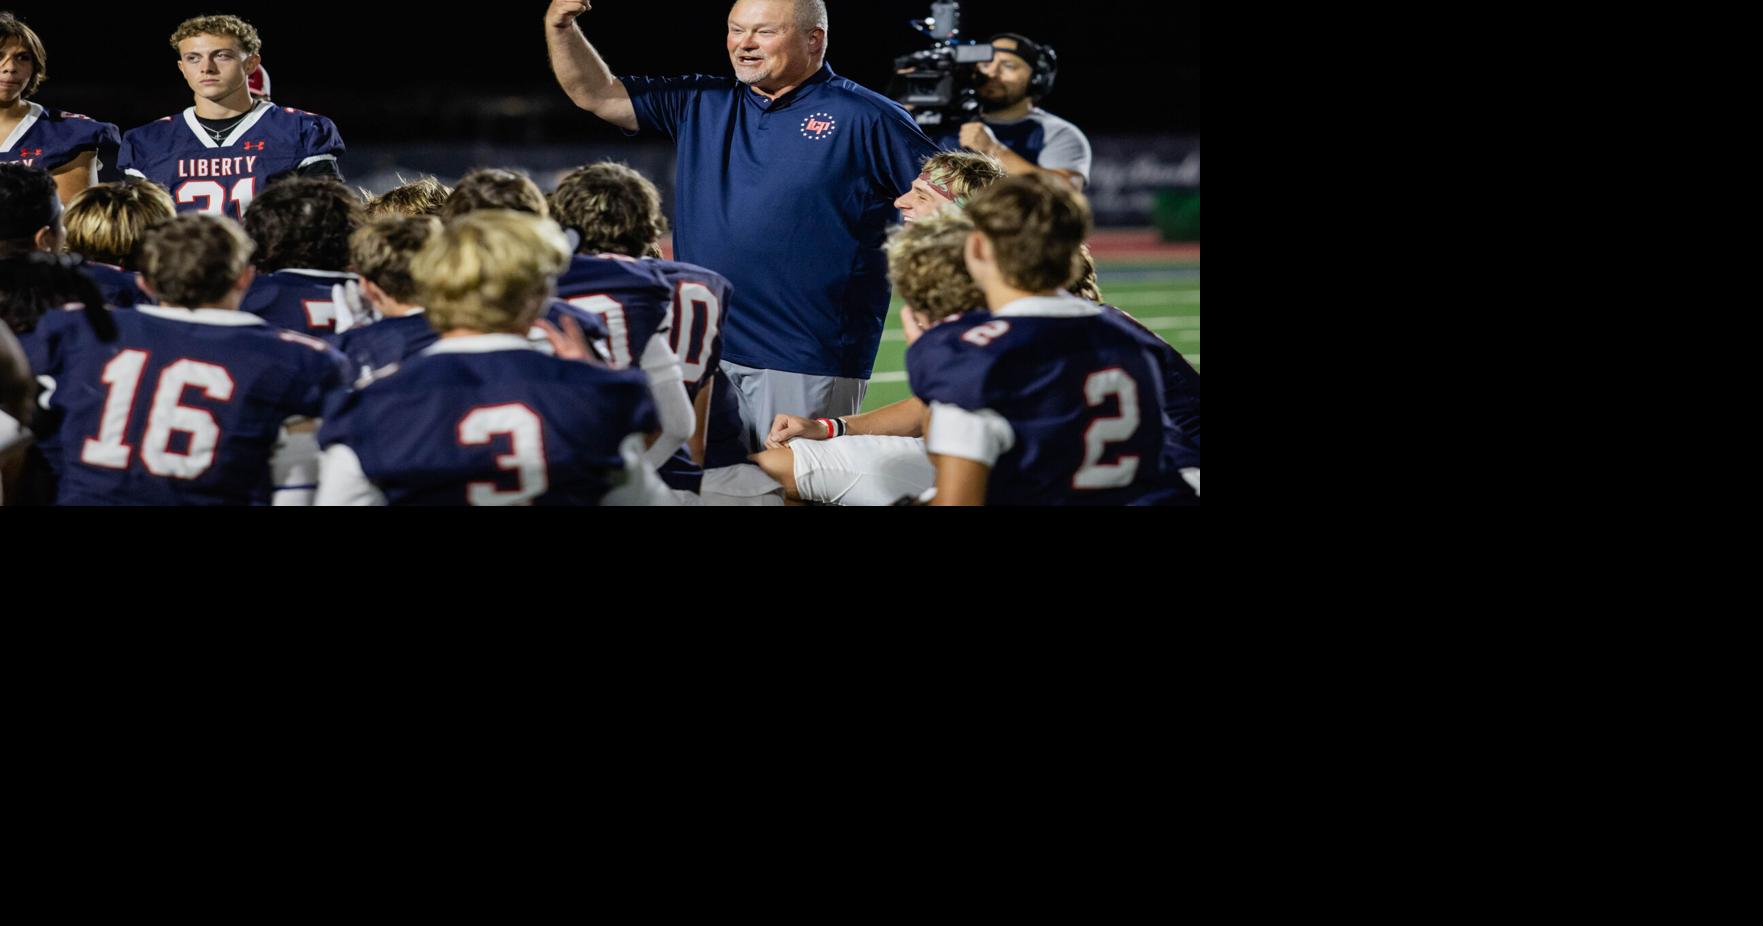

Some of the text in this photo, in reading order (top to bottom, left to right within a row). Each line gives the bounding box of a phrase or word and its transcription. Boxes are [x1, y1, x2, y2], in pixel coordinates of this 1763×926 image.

[178, 155, 257, 178] LIBERTY
[961, 318, 1011, 347] 2
[80, 348, 235, 480] 16
[456, 401, 548, 506] 3
[1072, 366, 1141, 489] 2
